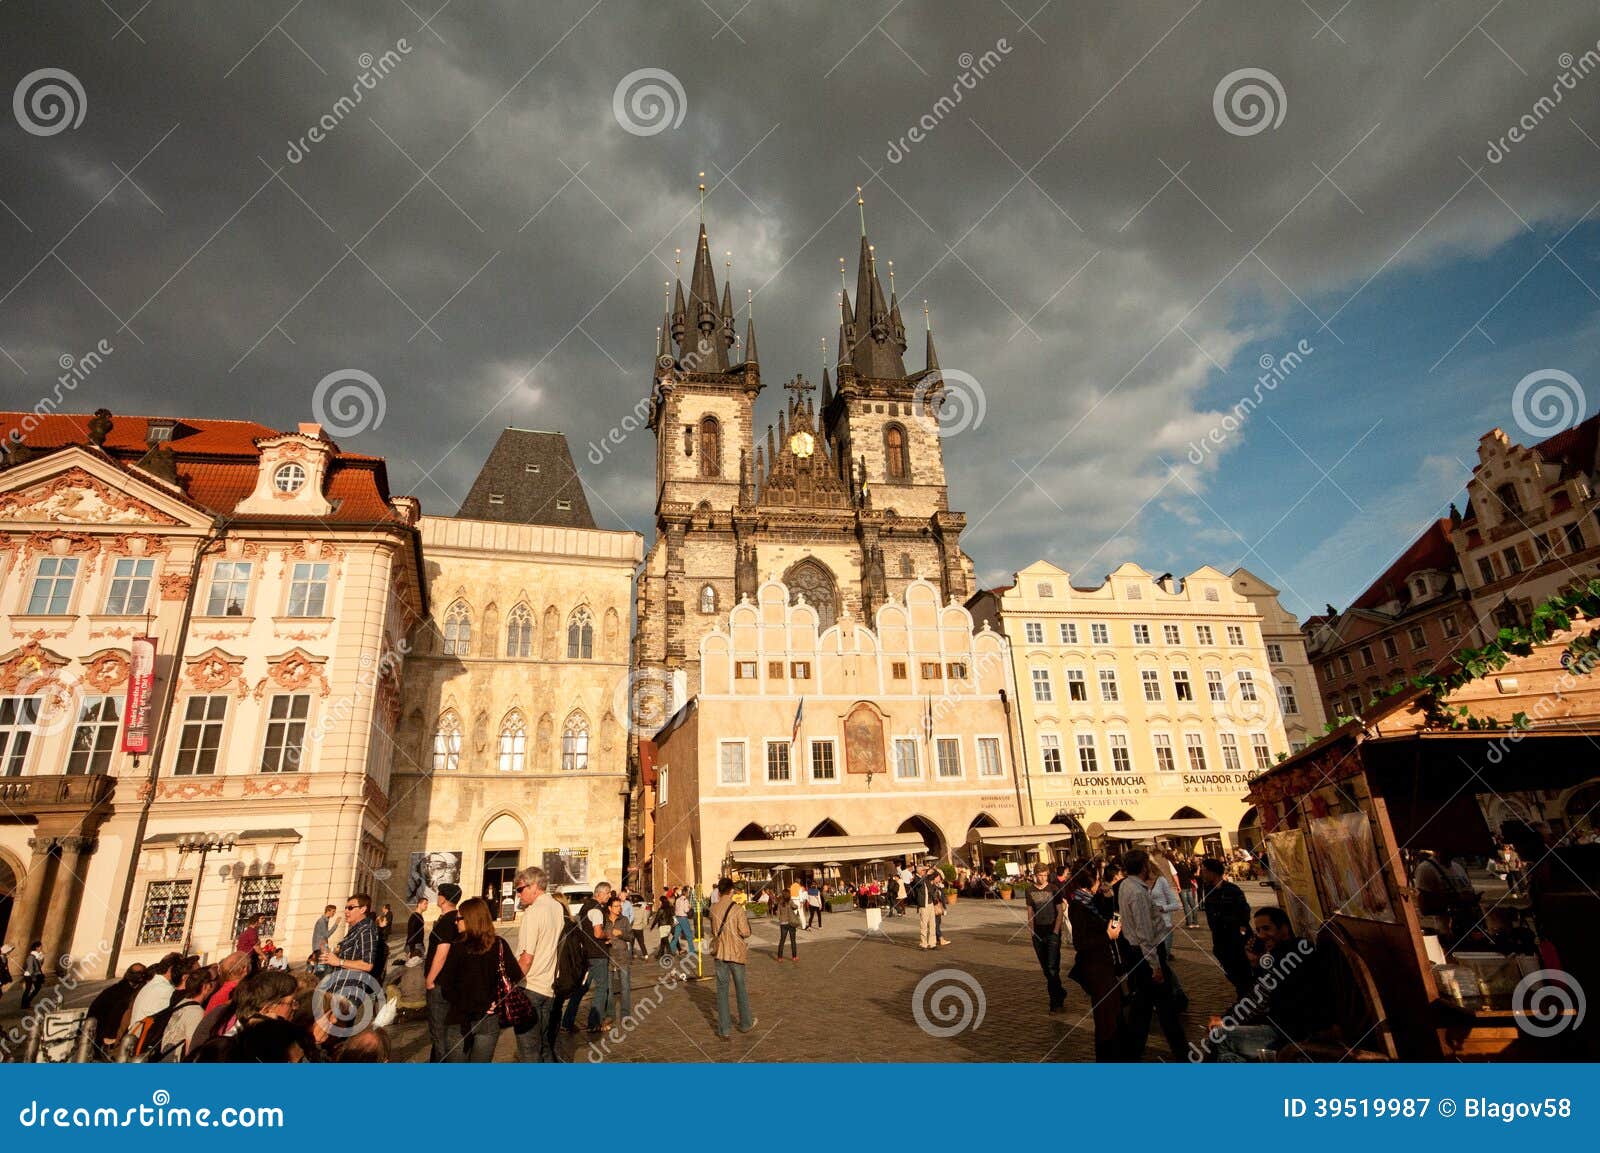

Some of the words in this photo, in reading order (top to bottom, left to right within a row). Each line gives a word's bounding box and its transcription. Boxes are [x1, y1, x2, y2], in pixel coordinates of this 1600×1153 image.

[1073, 777, 1110, 786] ALFONS
[1111, 776, 1146, 786] MUCHA
[1183, 774, 1232, 784] SALVADOR
[1076, 788, 1149, 796] exhibition
